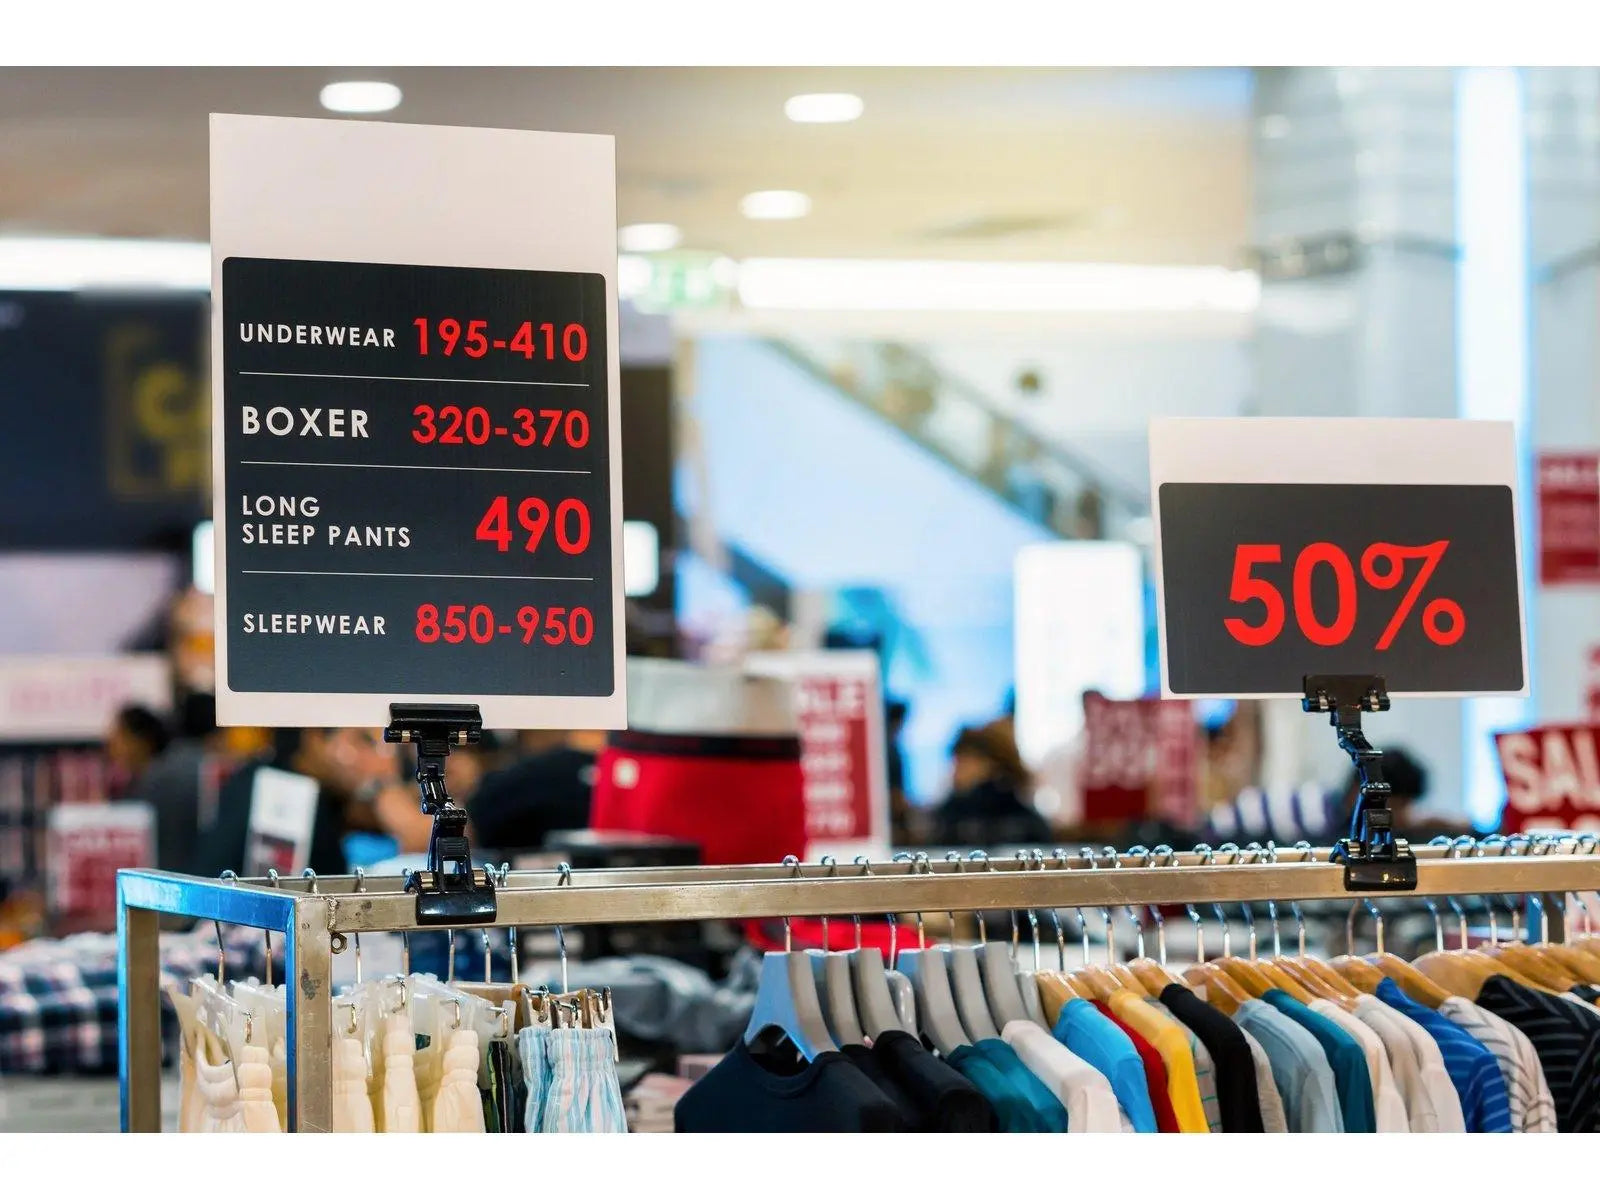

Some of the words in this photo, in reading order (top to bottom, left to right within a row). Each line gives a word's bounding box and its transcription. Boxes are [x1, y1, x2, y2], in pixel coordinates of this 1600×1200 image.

[240, 322, 396, 348] UNDERWEAR
[414, 318, 588, 362] 195-410
[242, 405, 369, 438] BOXER
[412, 404, 590, 449] 320-370
[242, 495, 320, 518] LONG
[475, 496, 591, 555] 490
[242, 523, 315, 545] SLEEP
[328, 525, 411, 548] PANTS
[1223, 540, 1466, 651] 50%
[243, 613, 386, 635] SLEEPWEAR
[415, 603, 594, 646] 850-950
